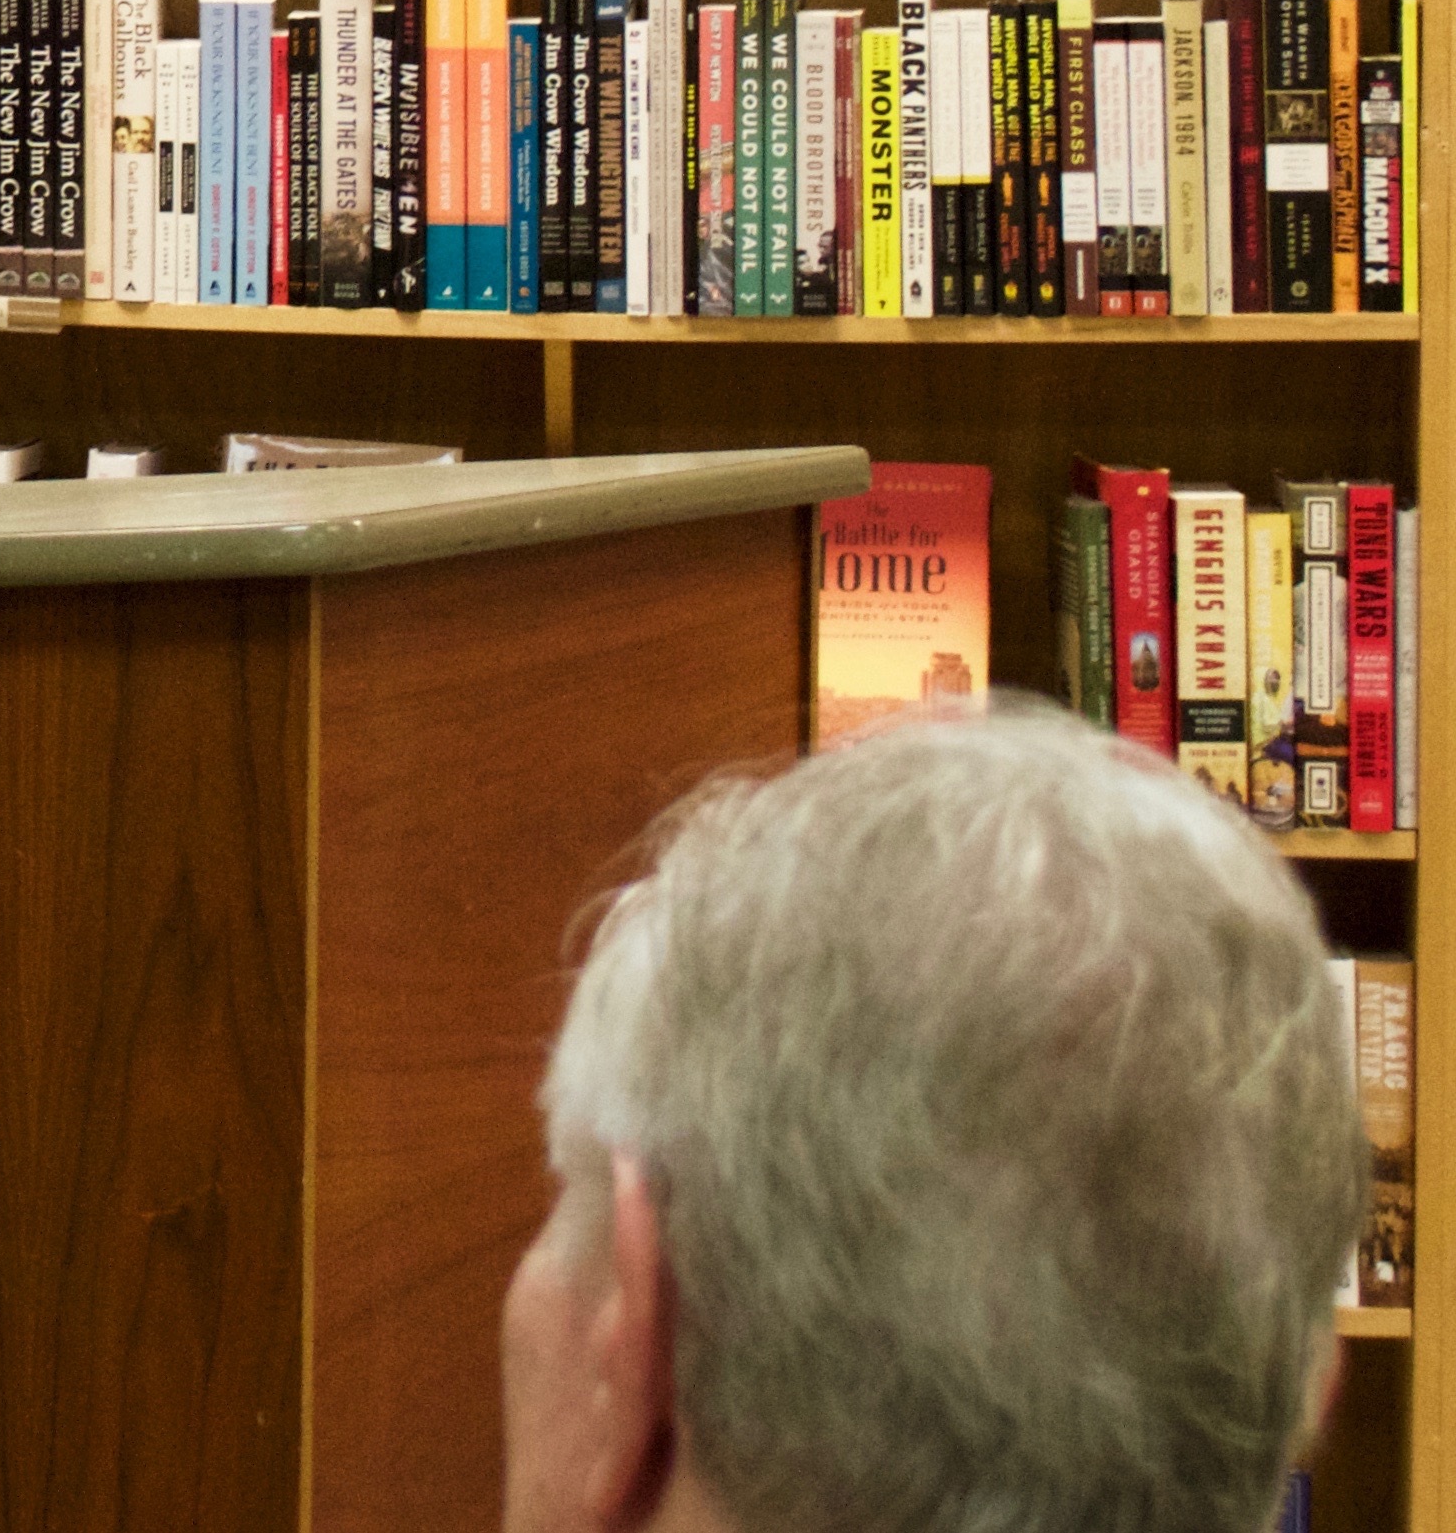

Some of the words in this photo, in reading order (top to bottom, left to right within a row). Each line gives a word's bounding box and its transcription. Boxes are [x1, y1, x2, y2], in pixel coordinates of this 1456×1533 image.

[0, 44, 19, 83] The
[742, 34, 758, 69] WE
[901, 1, 926, 93] BLACK
[0, 87, 19, 131] New
[741, 79, 758, 157] COULD
[870, 69, 894, 223] MONSTER
[902, 98, 928, 192] PANTHERS
[742, 165, 758, 215] NOT
[1364, 156, 1388, 261] MALCOLM
[741, 223, 756, 274] FAIL
[1364, 267, 1389, 284] X
[831, 525, 898, 548] Battle
[907, 525, 943, 547] for
[1194, 507, 1224, 612] GENGHIS
[1355, 504, 1374, 563] TONG
[821, 549, 947, 594] ome
[1355, 571, 1386, 641] WARS
[1195, 623, 1225, 692] KHAN
